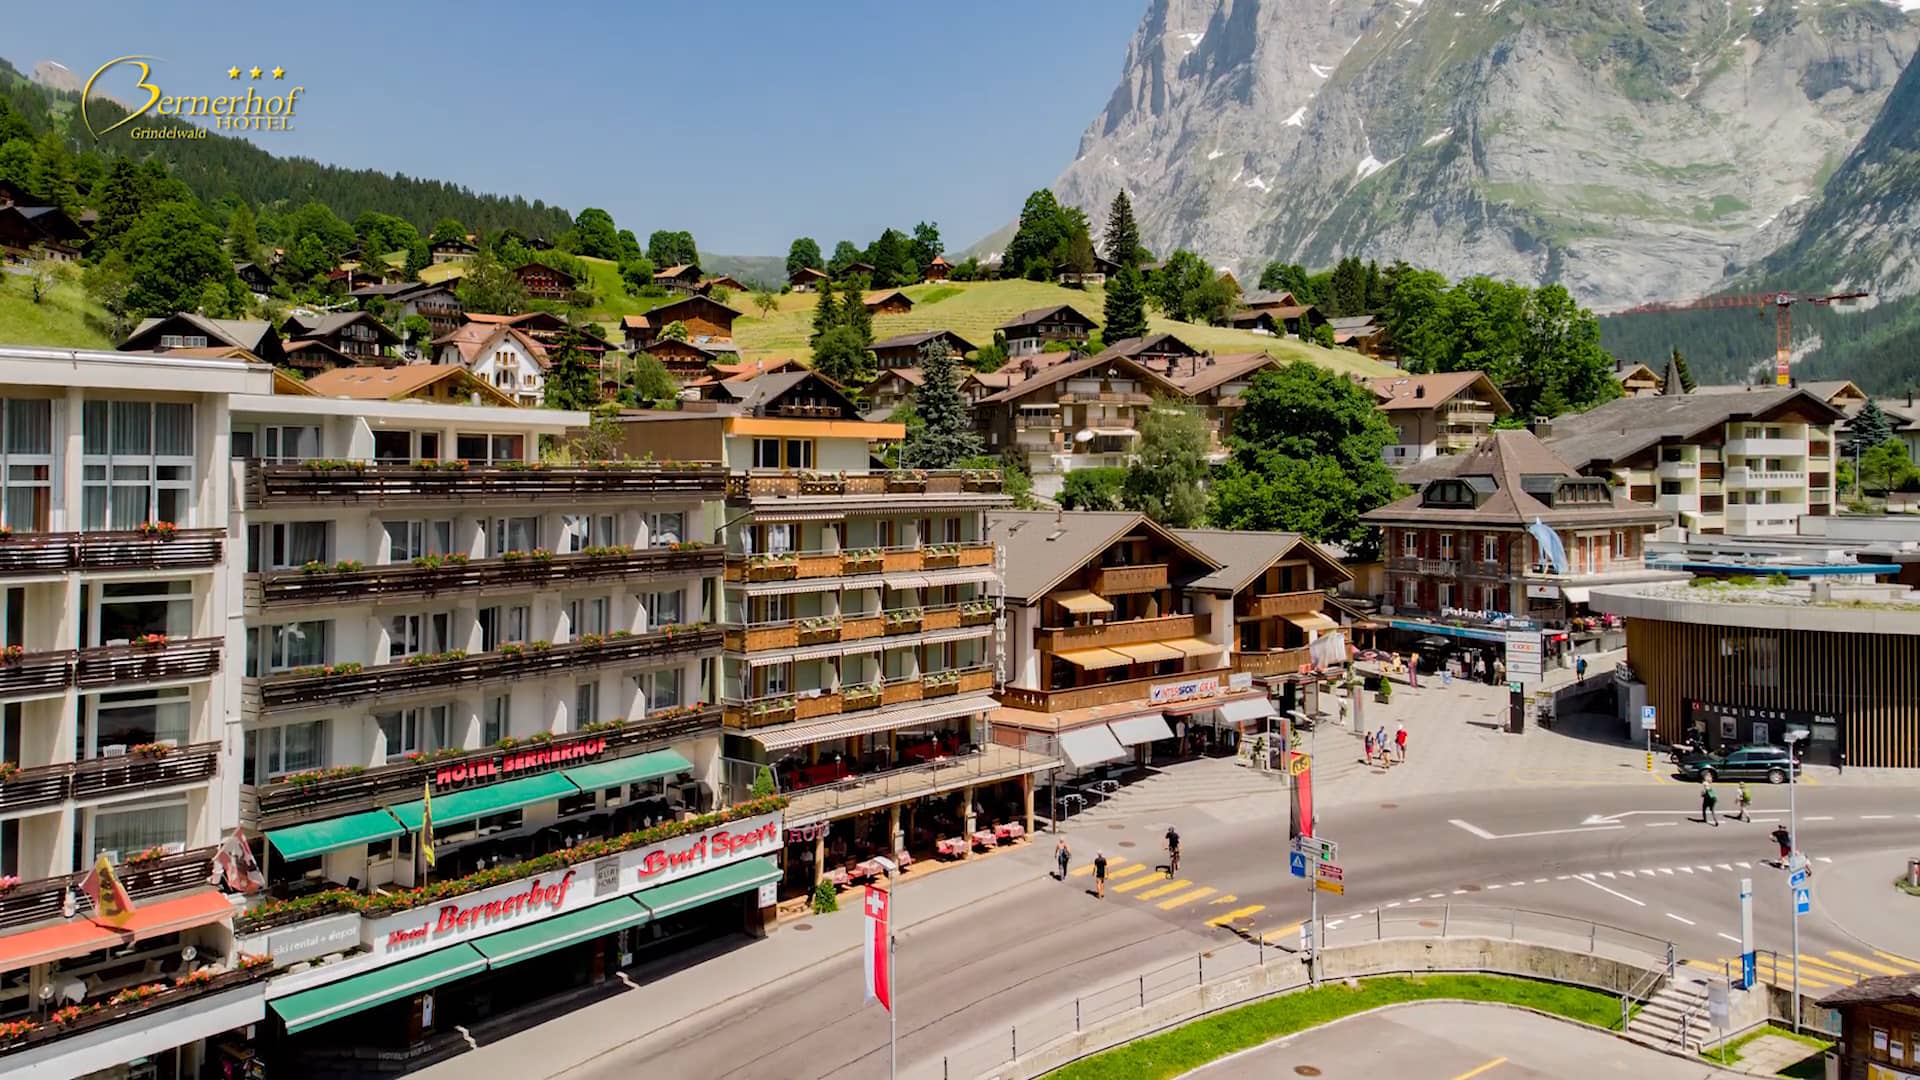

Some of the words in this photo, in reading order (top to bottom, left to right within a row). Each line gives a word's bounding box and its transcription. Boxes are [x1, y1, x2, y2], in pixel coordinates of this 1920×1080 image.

[1814, 715, 1836, 724] Bank
[437, 758, 498, 785] HOTEL
[502, 736, 607, 773] BERNERHOF
[638, 835, 708, 878] Buri
[711, 821, 777, 857] Sport
[389, 922, 429, 946] Hotel
[433, 870, 576, 934] Bernerhof
